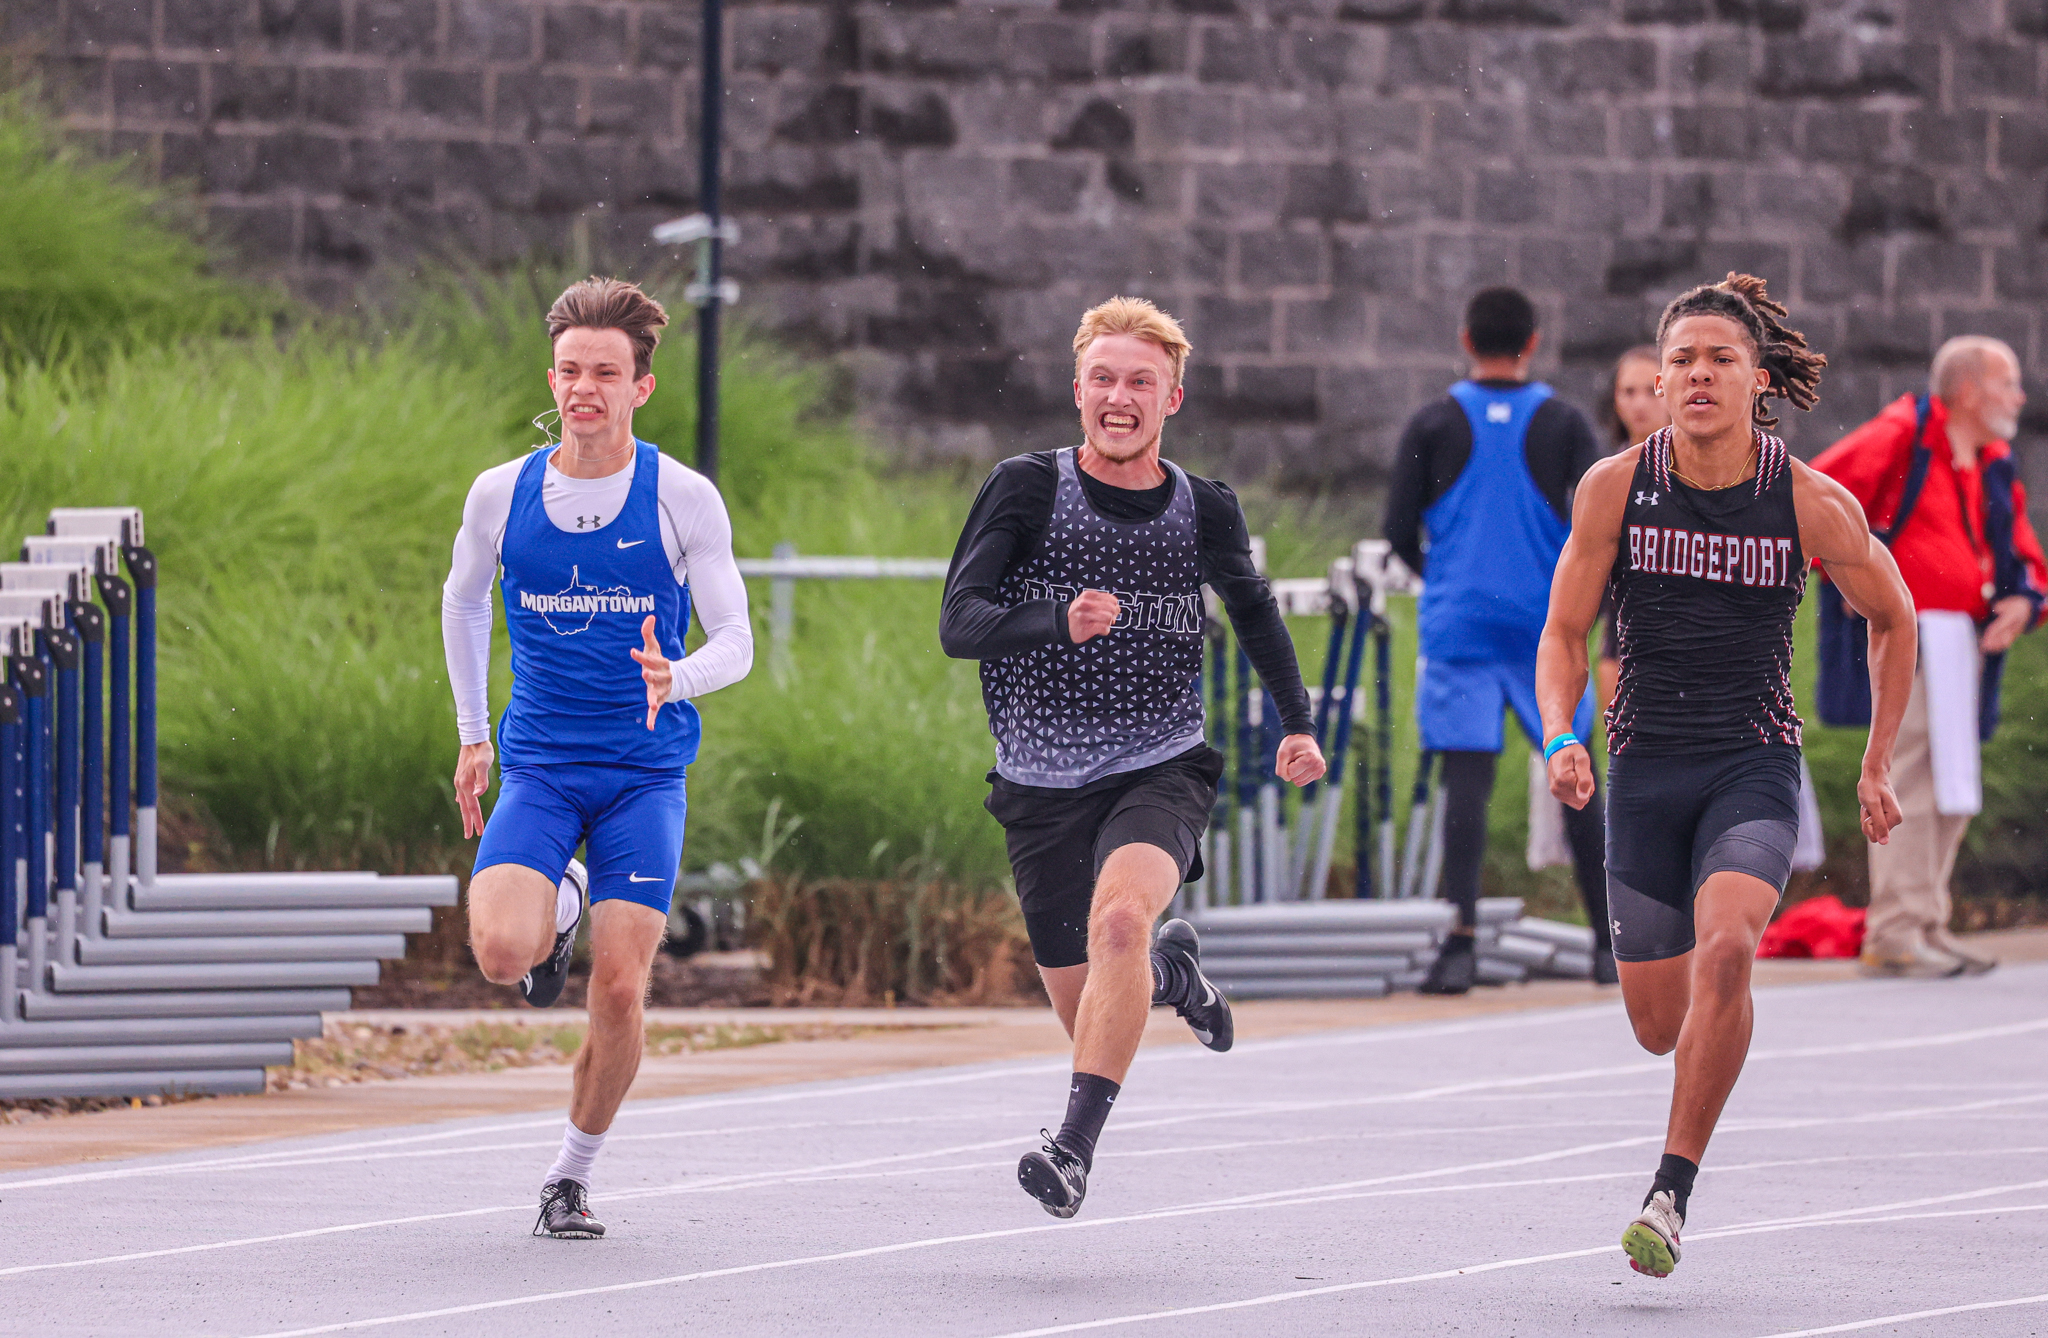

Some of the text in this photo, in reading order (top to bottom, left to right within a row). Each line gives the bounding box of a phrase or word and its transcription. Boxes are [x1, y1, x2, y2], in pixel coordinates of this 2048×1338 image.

[1628, 525, 1793, 587] BRIDGEPORT
[520, 591, 655, 613] MORGANTOWN
[1024, 579, 1200, 633] PSTON
